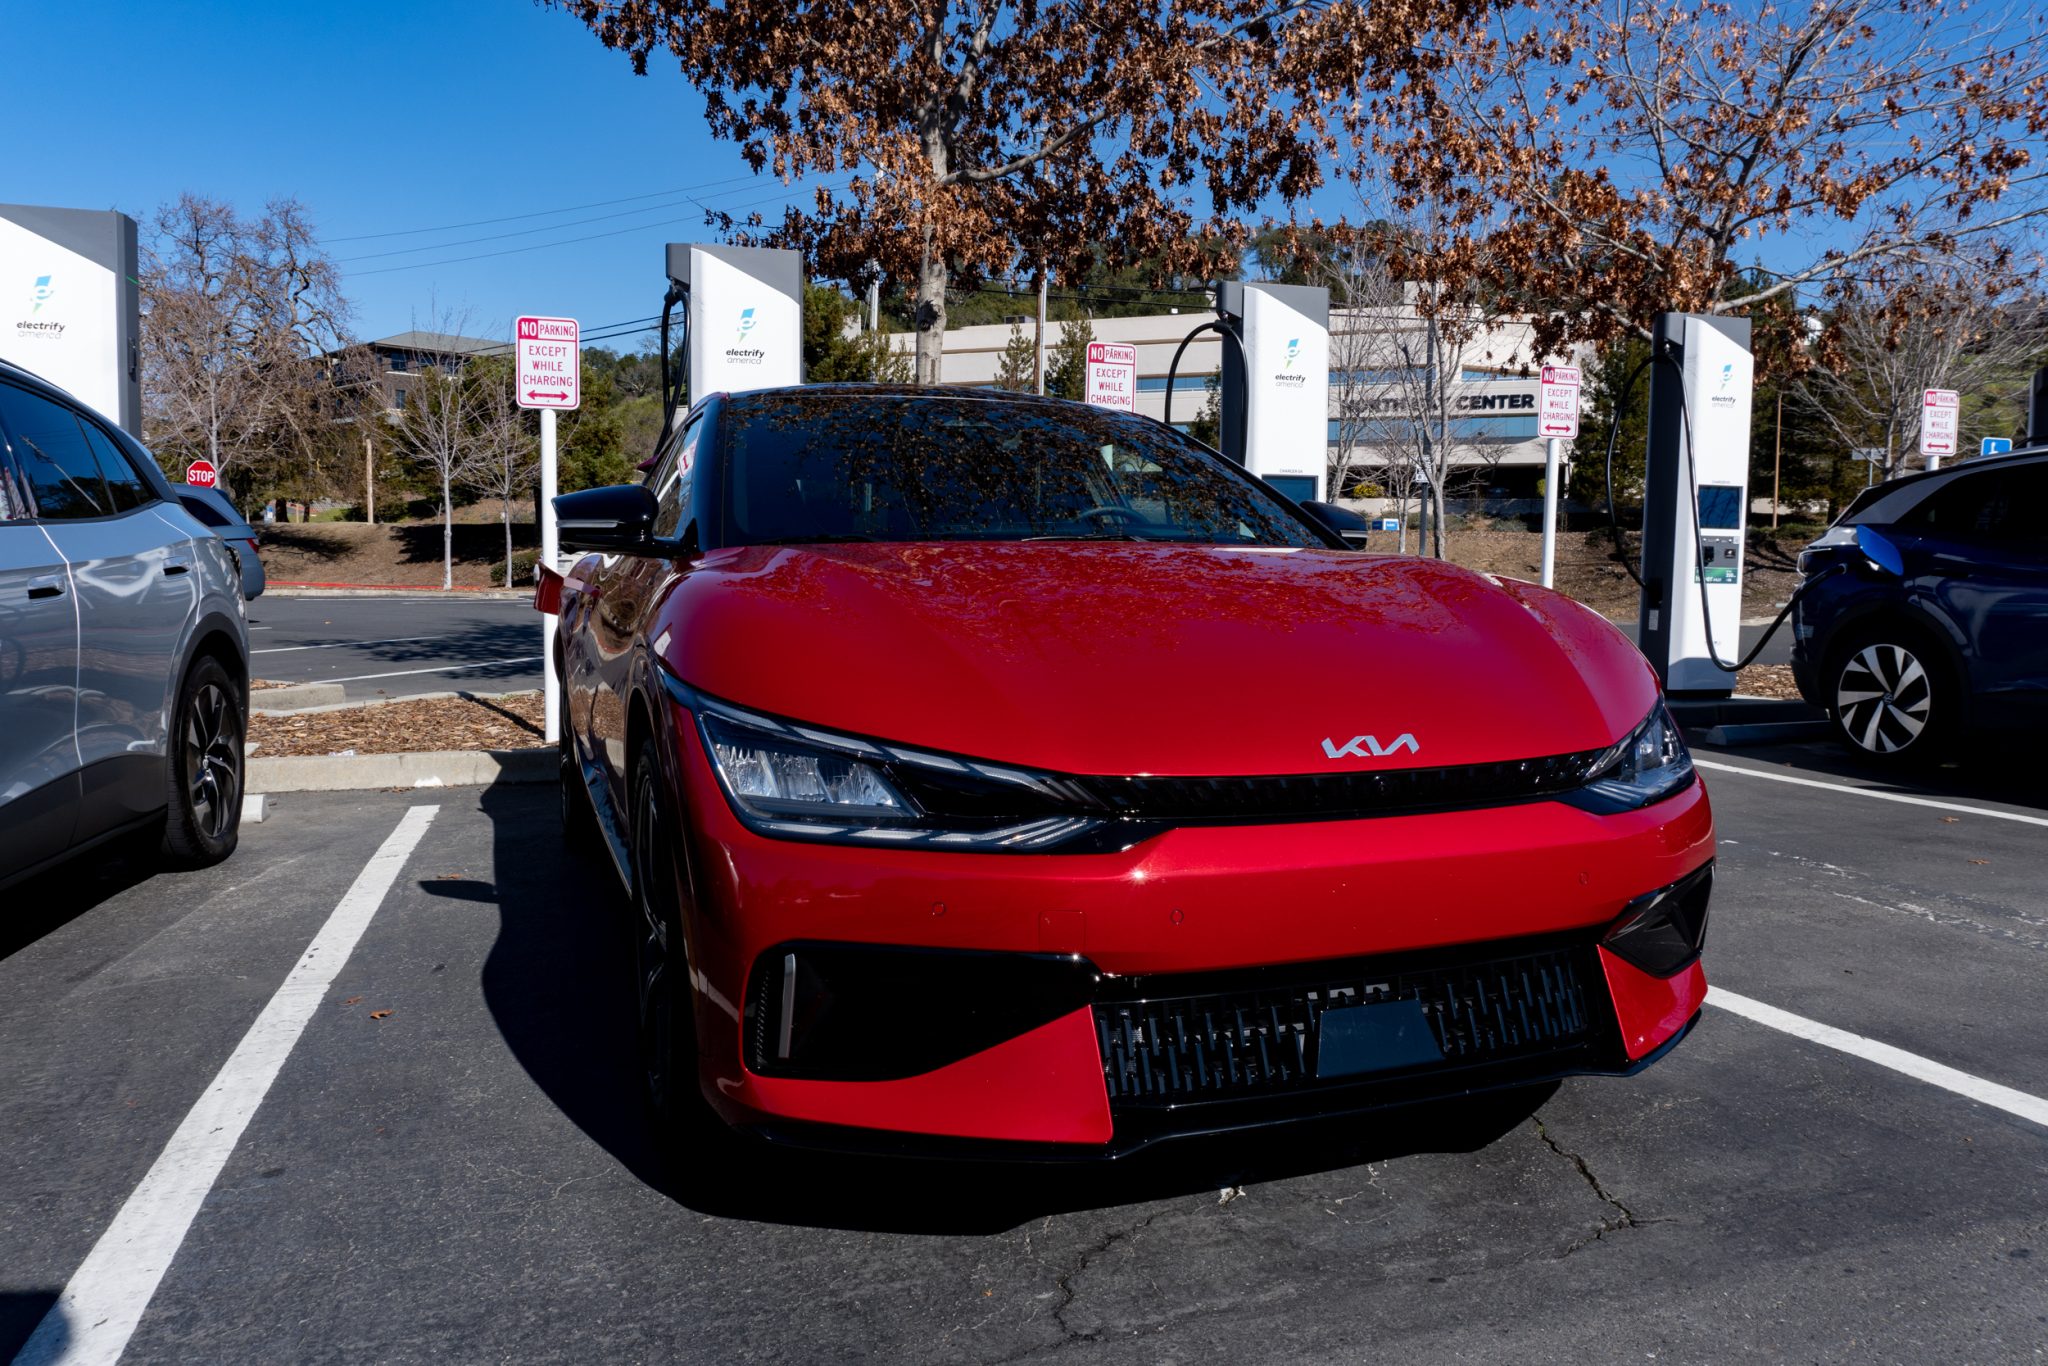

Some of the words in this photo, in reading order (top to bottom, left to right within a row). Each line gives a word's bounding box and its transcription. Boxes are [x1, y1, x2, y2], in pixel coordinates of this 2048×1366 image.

[16, 320, 66, 332] electrify
[521, 321, 537, 336] NO
[540, 324, 574, 337] PARKING
[18, 330, 61, 340] america
[528, 345, 567, 357] EXCEPT
[725, 348, 765, 359] electrify
[1090, 346, 1104, 361] NO
[1105, 349, 1133, 361] PARKING
[532, 360, 564, 372] WHILE
[727, 357, 762, 365] america
[1096, 368, 1127, 379] EXCEPT
[1274, 373, 1306, 383] electrify
[1543, 369, 1555, 382] NO
[1555, 371, 1578, 382] PARKING
[523, 374, 573, 387] CHARGING
[1098, 381, 1124, 392] WHILE
[1547, 388, 1573, 398] EXCEPT
[1090, 394, 1131, 406] CHARGING
[1455, 394, 1535, 410] CENTER
[1926, 393, 1937, 405] NO
[1549, 400, 1569, 410] WHILE
[1542, 411, 1575, 422] CHARGING
[1929, 410, 1953, 419] EXCEPT
[1931, 421, 1950, 430] WHILE
[1925, 431, 1954, 441] CHARGING
[189, 469, 215, 483] STOP
[1321, 733, 1420, 759] KIA
